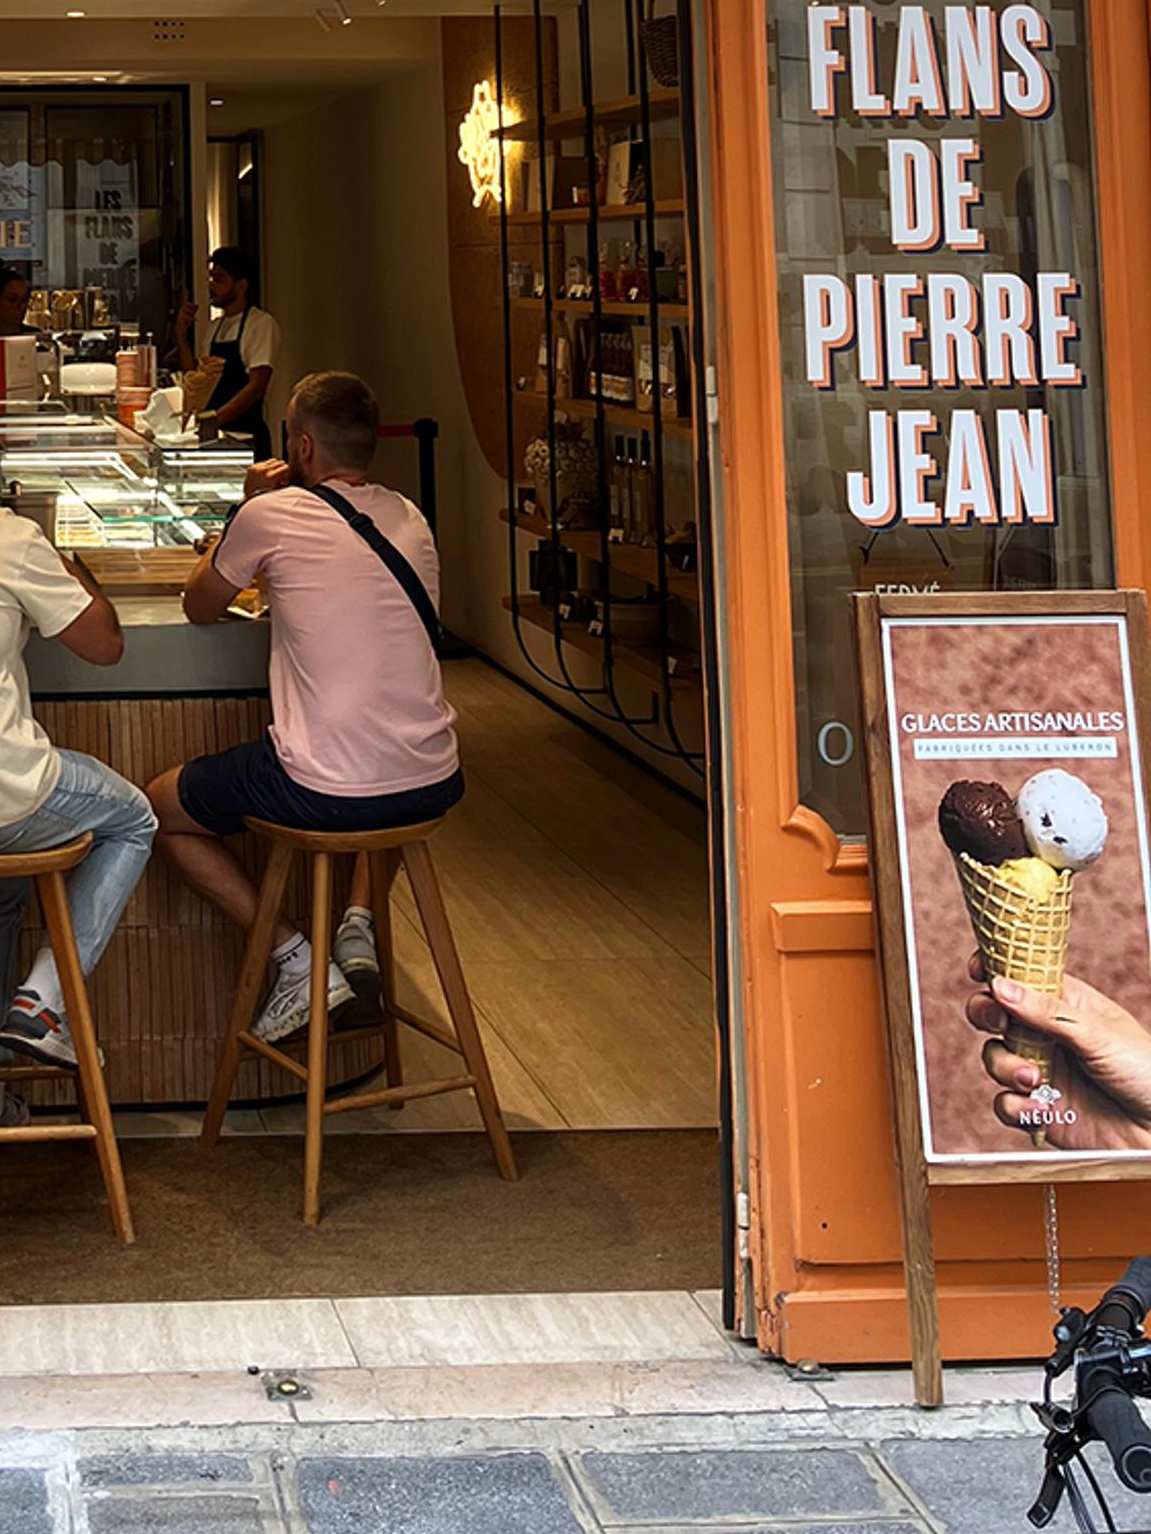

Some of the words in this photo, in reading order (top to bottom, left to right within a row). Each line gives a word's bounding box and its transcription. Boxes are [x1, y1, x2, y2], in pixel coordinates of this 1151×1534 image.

[807, 4, 1055, 120] FLANS
[887, 138, 987, 254] DE
[803, 272, 1086, 390] PIERRE
[847, 409, 1059, 529] JEAN
[901, 713, 982, 733] GLACES
[984, 712, 1124, 732] ARTISANALES
